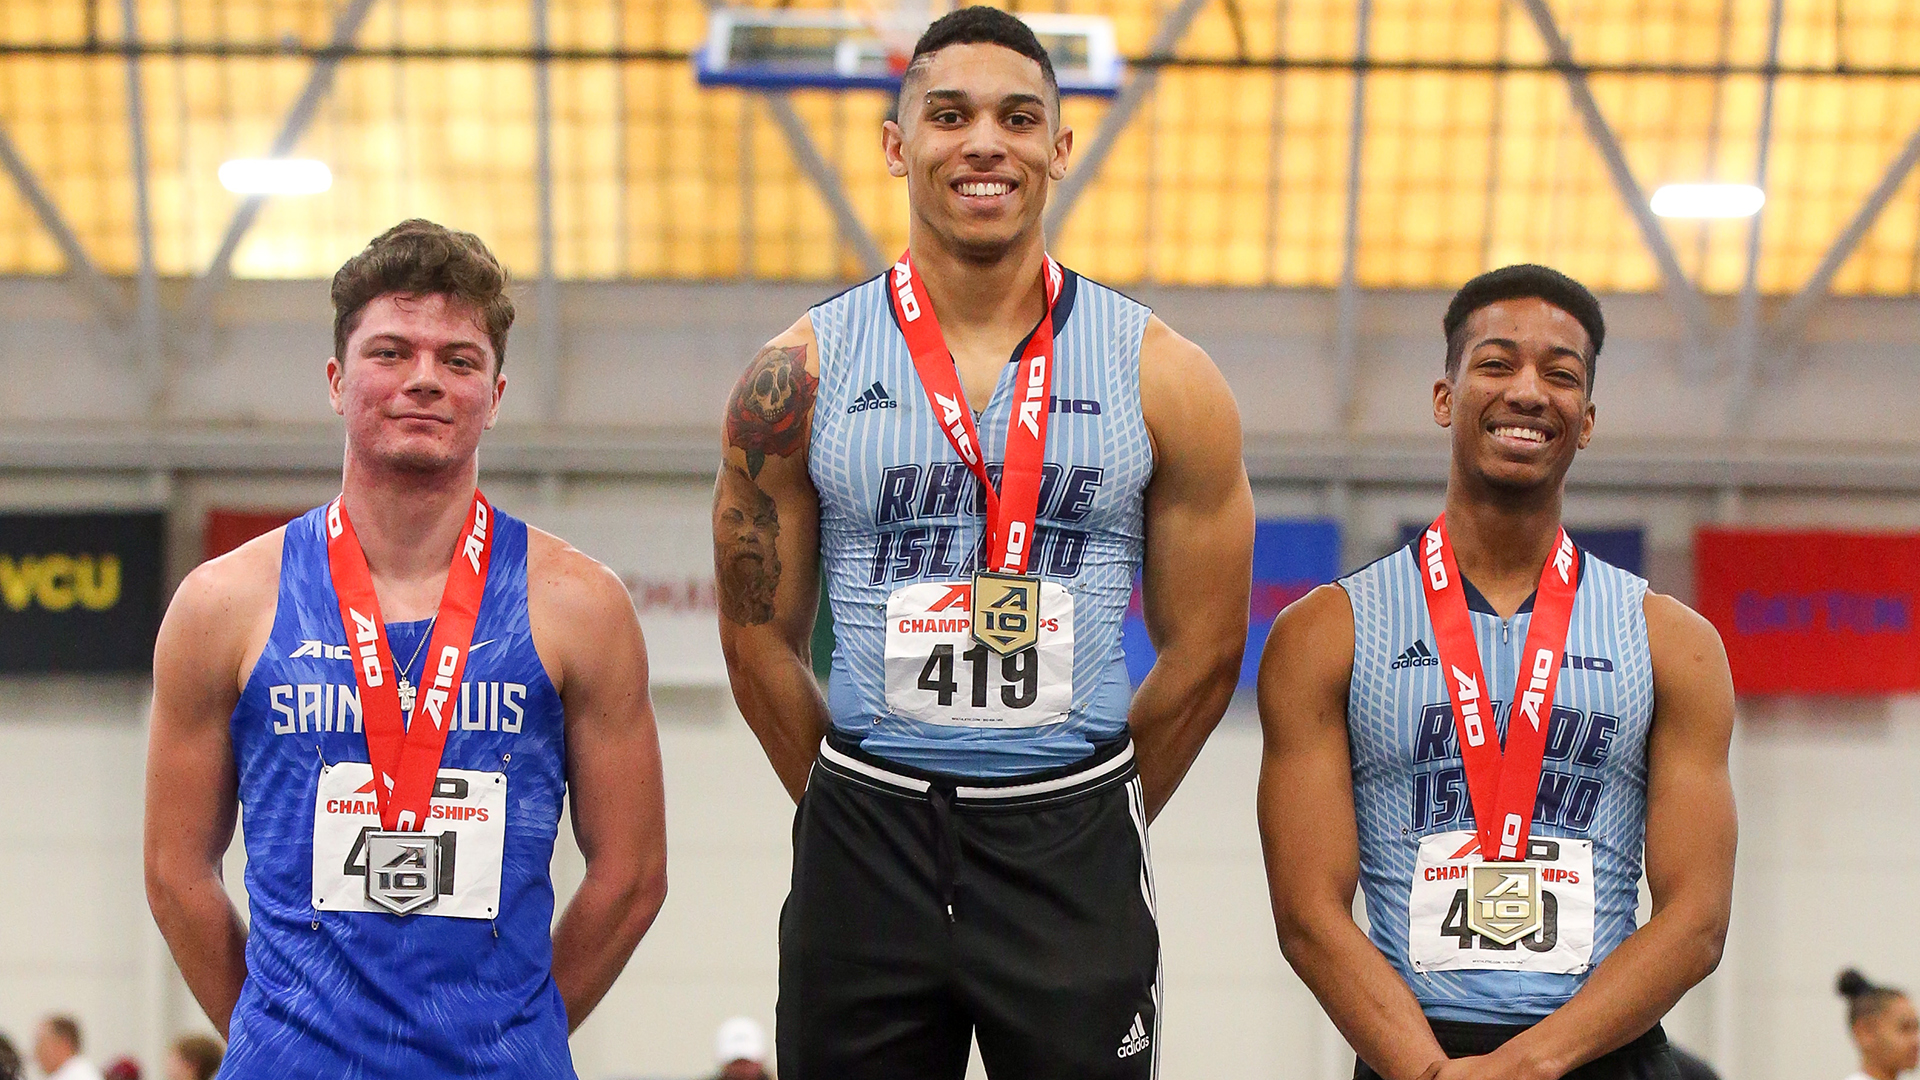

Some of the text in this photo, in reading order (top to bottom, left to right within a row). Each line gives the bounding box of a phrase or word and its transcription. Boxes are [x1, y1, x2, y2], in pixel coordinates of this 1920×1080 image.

[893, 257, 921, 322] A10
[847, 398, 897, 414] adidas
[934, 391, 978, 466] A10
[1018, 355, 1046, 440] A10
[1050, 395, 1101, 415] 10
[461, 500, 488, 575] A10
[1425, 526, 1449, 591] A10
[0, 553, 121, 612] VCU
[348, 607, 385, 688] A10
[980, 610, 1029, 632] 10
[422, 645, 460, 731] A10
[917, 644, 1039, 709] 419
[1391, 656, 1439, 670] adidas
[1519, 648, 1554, 733] A10
[1561, 652, 1614, 673] 10
[269, 681, 527, 736] SAIN UIS
[1413, 700, 1620, 769] RDE
[1451, 664, 1485, 748] A10
[343, 826, 457, 896] 41
[374, 869, 427, 890] 10
[1476, 899, 1531, 919] 10
[1117, 1036, 1150, 1058] adidas
